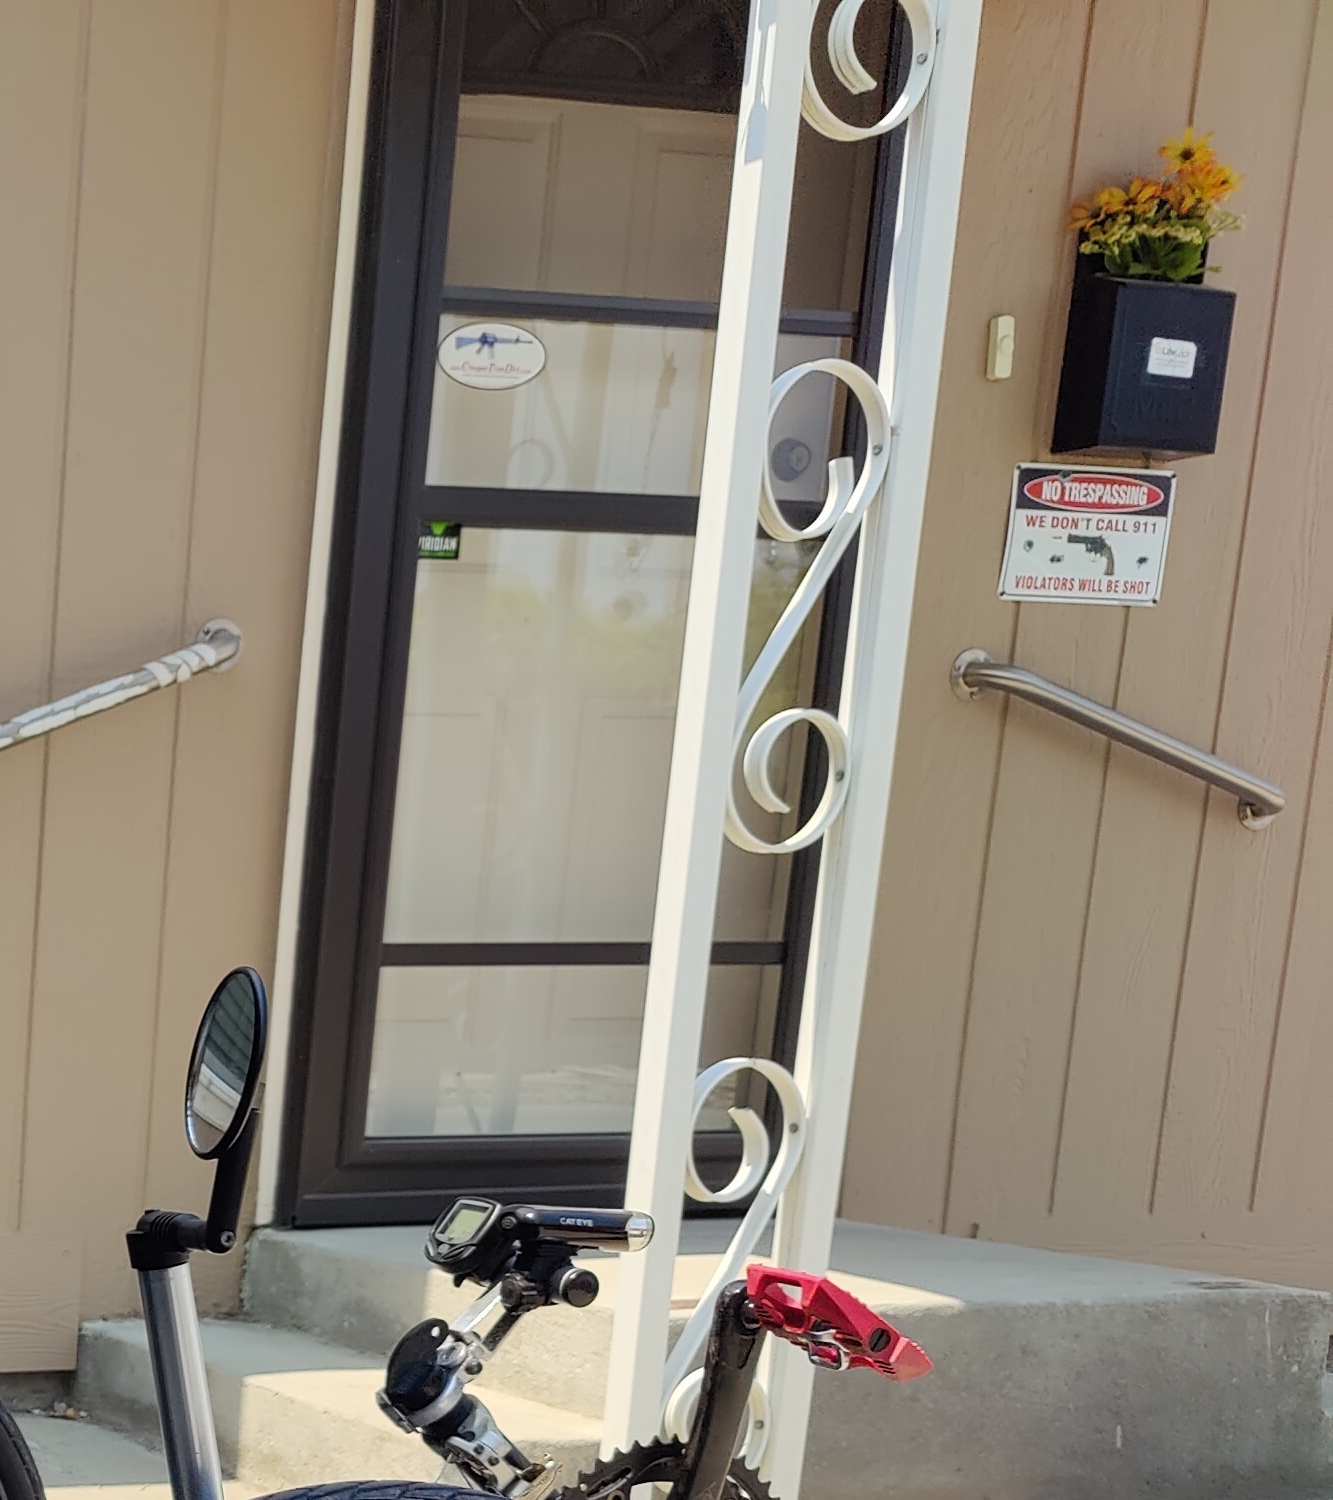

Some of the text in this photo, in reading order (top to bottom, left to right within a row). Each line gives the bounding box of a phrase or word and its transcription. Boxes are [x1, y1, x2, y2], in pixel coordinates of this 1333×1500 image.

[1041, 481, 1148, 505] NO TRESPASSING
[1026, 515, 1158, 534] WE DON'T CALL 911
[1014, 575, 1151, 594] VIOLATORS WILL BE SHOT
